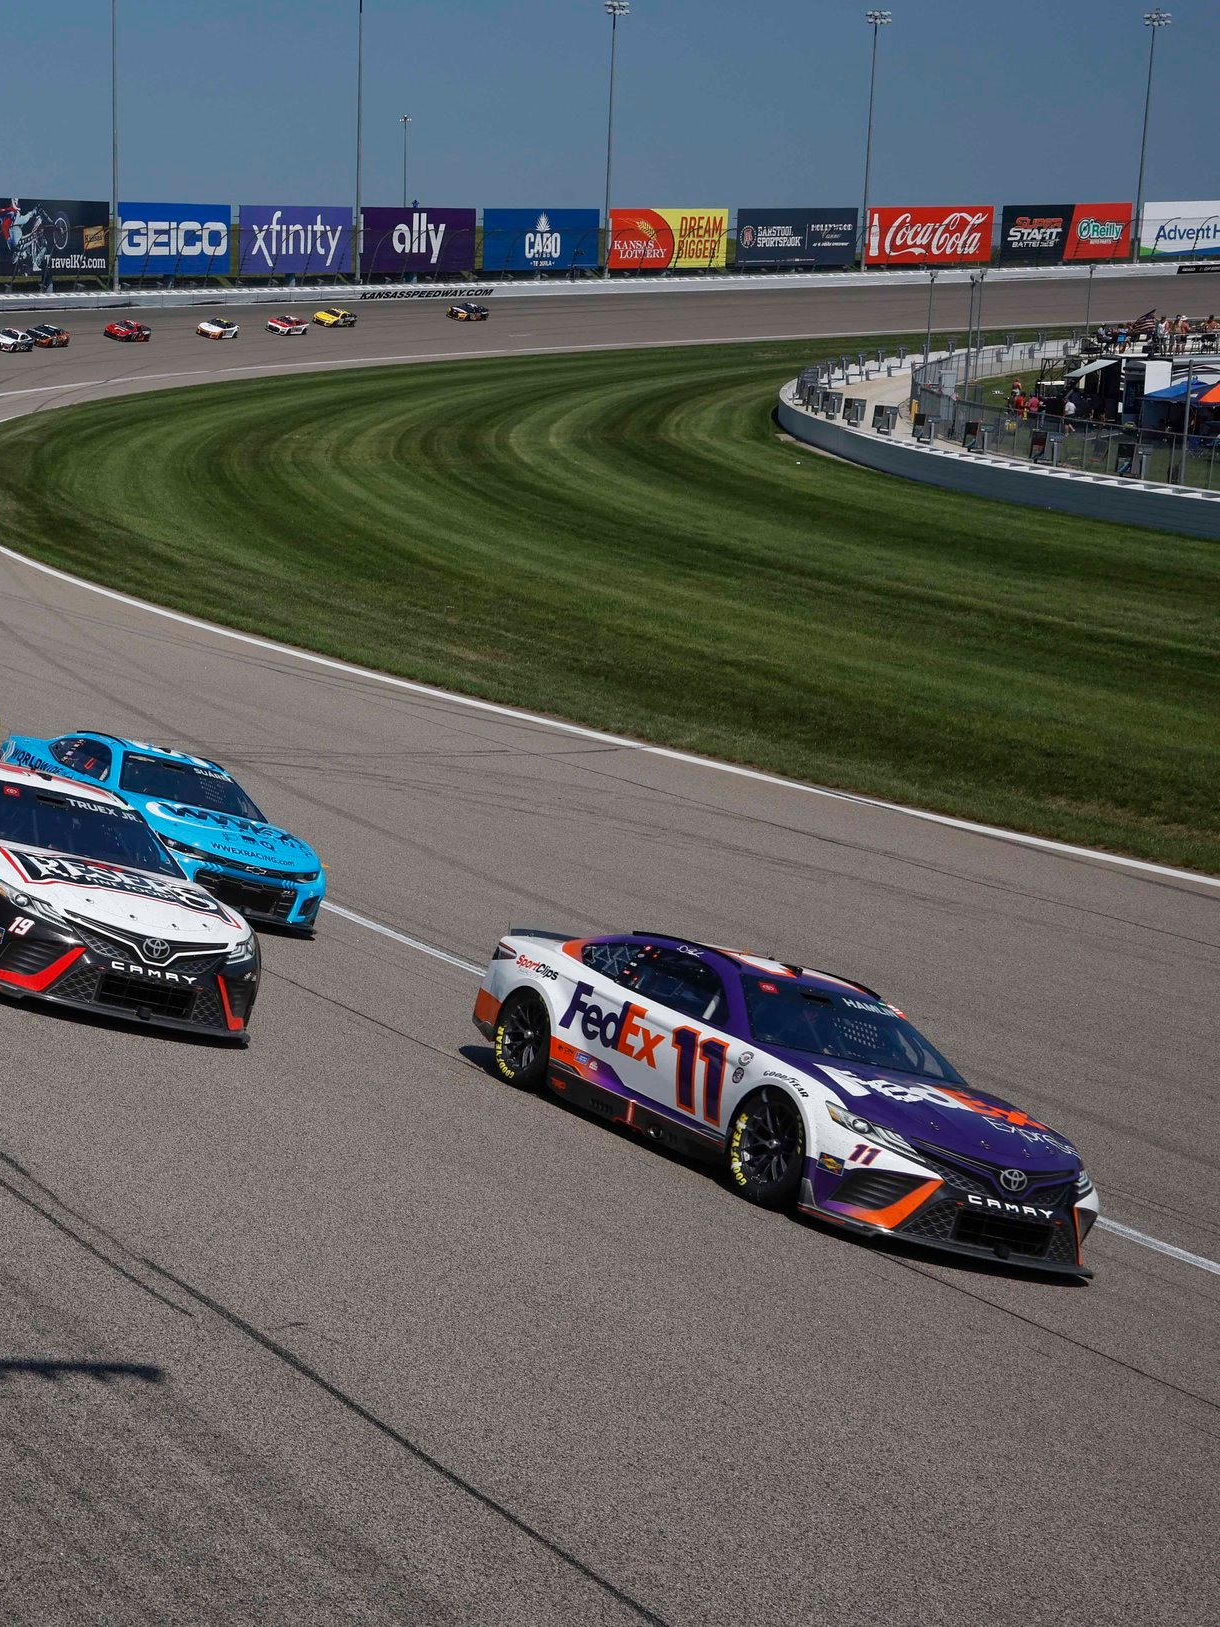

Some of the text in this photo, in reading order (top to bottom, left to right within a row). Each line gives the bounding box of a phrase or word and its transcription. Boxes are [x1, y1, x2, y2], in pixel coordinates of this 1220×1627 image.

[680, 216, 723, 239] DREAM
[884, 213, 988, 255] Coca-Cola
[1007, 227, 1063, 240] START
[1015, 216, 1063, 228] SUPER
[1078, 218, 1123, 240] O'Reilly
[121, 220, 228, 256] GEICO
[251, 211, 342, 267] xfinity
[392, 213, 446, 263] ally
[525, 232, 560, 258] CABO
[614, 240, 654, 250] KANSAS
[678, 239, 722, 259] BIGGER!
[45, 255, 106, 269] TravelKS.com
[620, 249, 667, 259] LOTTERY
[360, 288, 494, 300] KANSASSPEEDWAY.COM
[66, 797, 143, 824] TRUEX JR.
[211, 842, 295, 867] WWEXRACING.com
[8, 916, 35, 936] 19
[111, 960, 197, 985] CAMRY
[843, 998, 900, 1019] HAMLIN
[559, 980, 666, 1070] FedEx
[495, 1025, 515, 1079] GOODYEAR
[672, 1024, 731, 1128] 11
[763, 1070, 809, 1098] GOODYEAR
[848, 1143, 882, 1167] 11
[967, 1193, 1054, 1219] CAMRY
